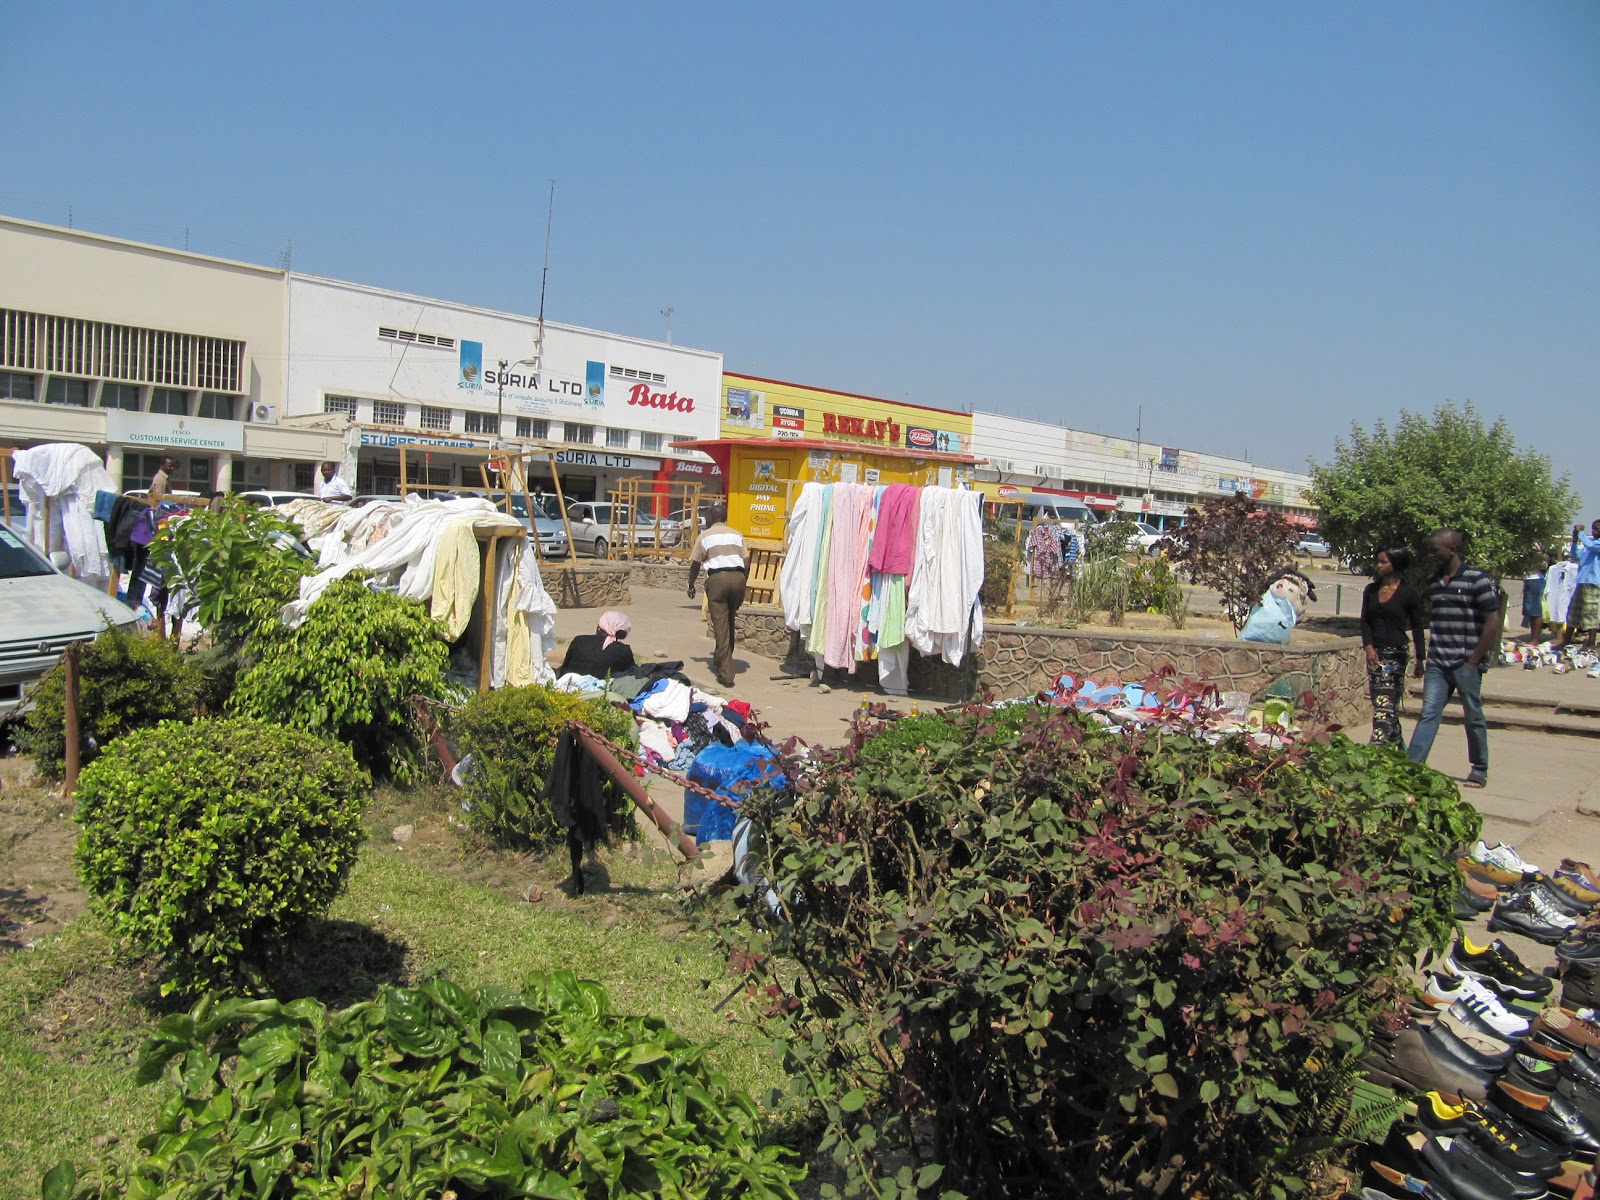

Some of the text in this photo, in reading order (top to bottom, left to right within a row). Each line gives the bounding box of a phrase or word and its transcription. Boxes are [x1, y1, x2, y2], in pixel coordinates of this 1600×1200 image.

[457, 381, 483, 391] SURIA
[484, 370, 582, 396] SURIA LTD
[584, 398, 605, 408] SURIA
[627, 383, 695, 413] Bata
[822, 412, 901, 441] REKAY'S
[129, 433, 225, 447] CUSTOMER SERVICE CENTER
[556, 451, 631, 468] SURIA LTD
[676, 461, 703, 473] Bata
[749, 484, 779, 492] DIGITAL
[750, 503, 776, 512] PHONE
